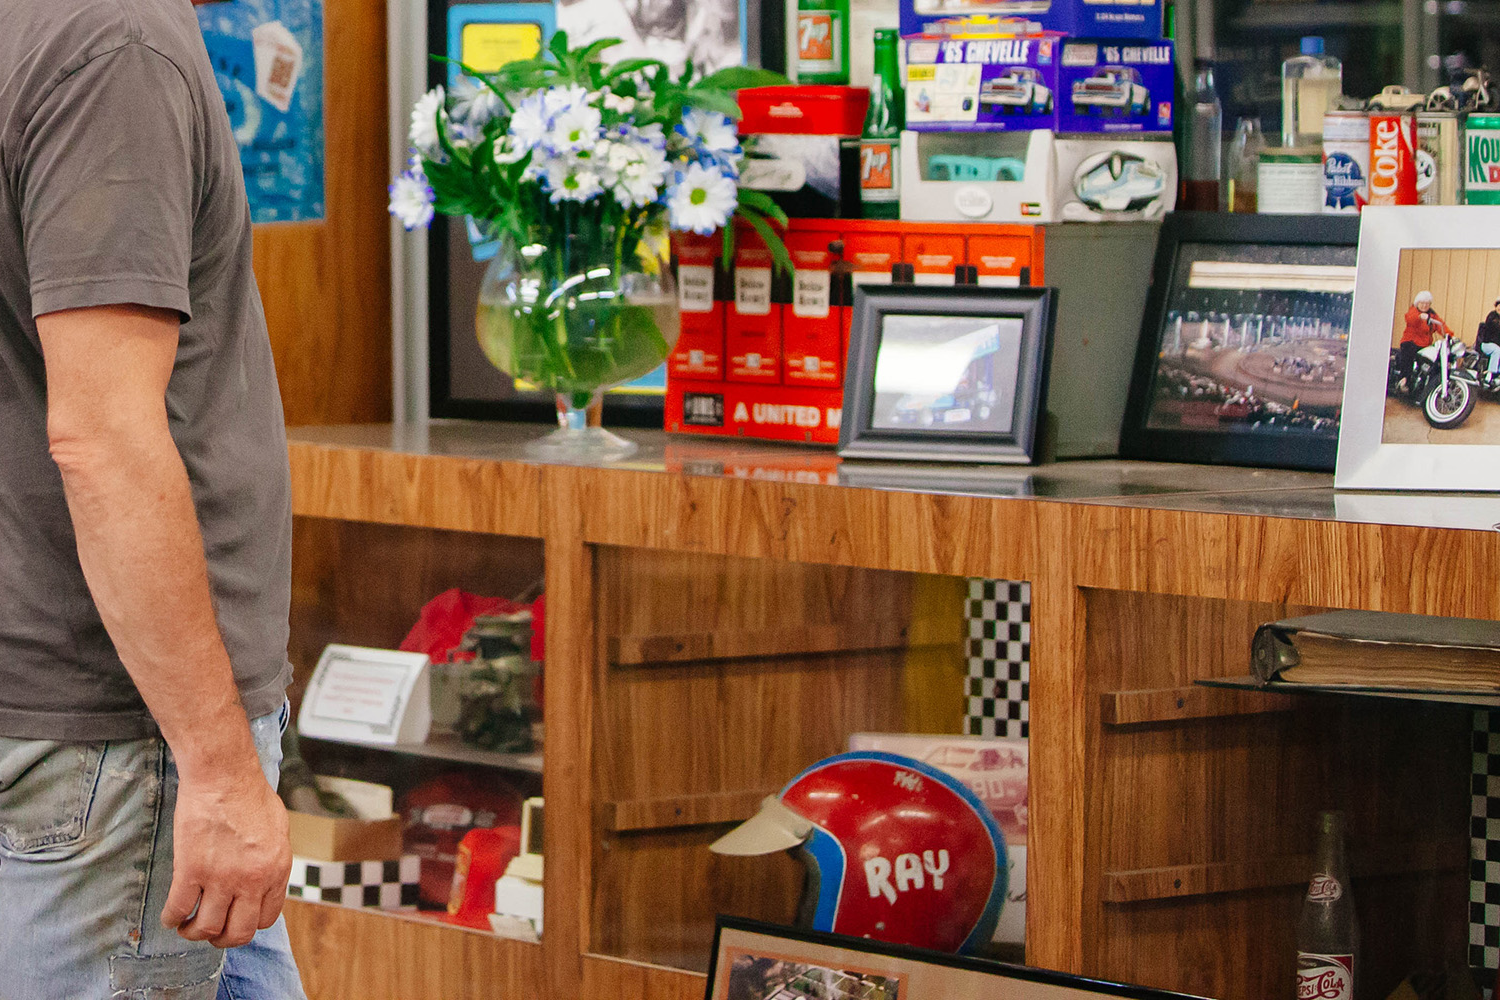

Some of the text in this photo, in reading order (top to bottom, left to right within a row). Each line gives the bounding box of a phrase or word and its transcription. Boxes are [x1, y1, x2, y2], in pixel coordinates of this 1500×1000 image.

[965, 41, 1030, 64] CHEVELLE
[1121, 46, 1170, 64] CHEVELLE
[1372, 120, 1399, 196] Coke
[733, 401, 750, 422] A
[751, 402, 821, 427] UNITED
[863, 849, 951, 907] RAY
